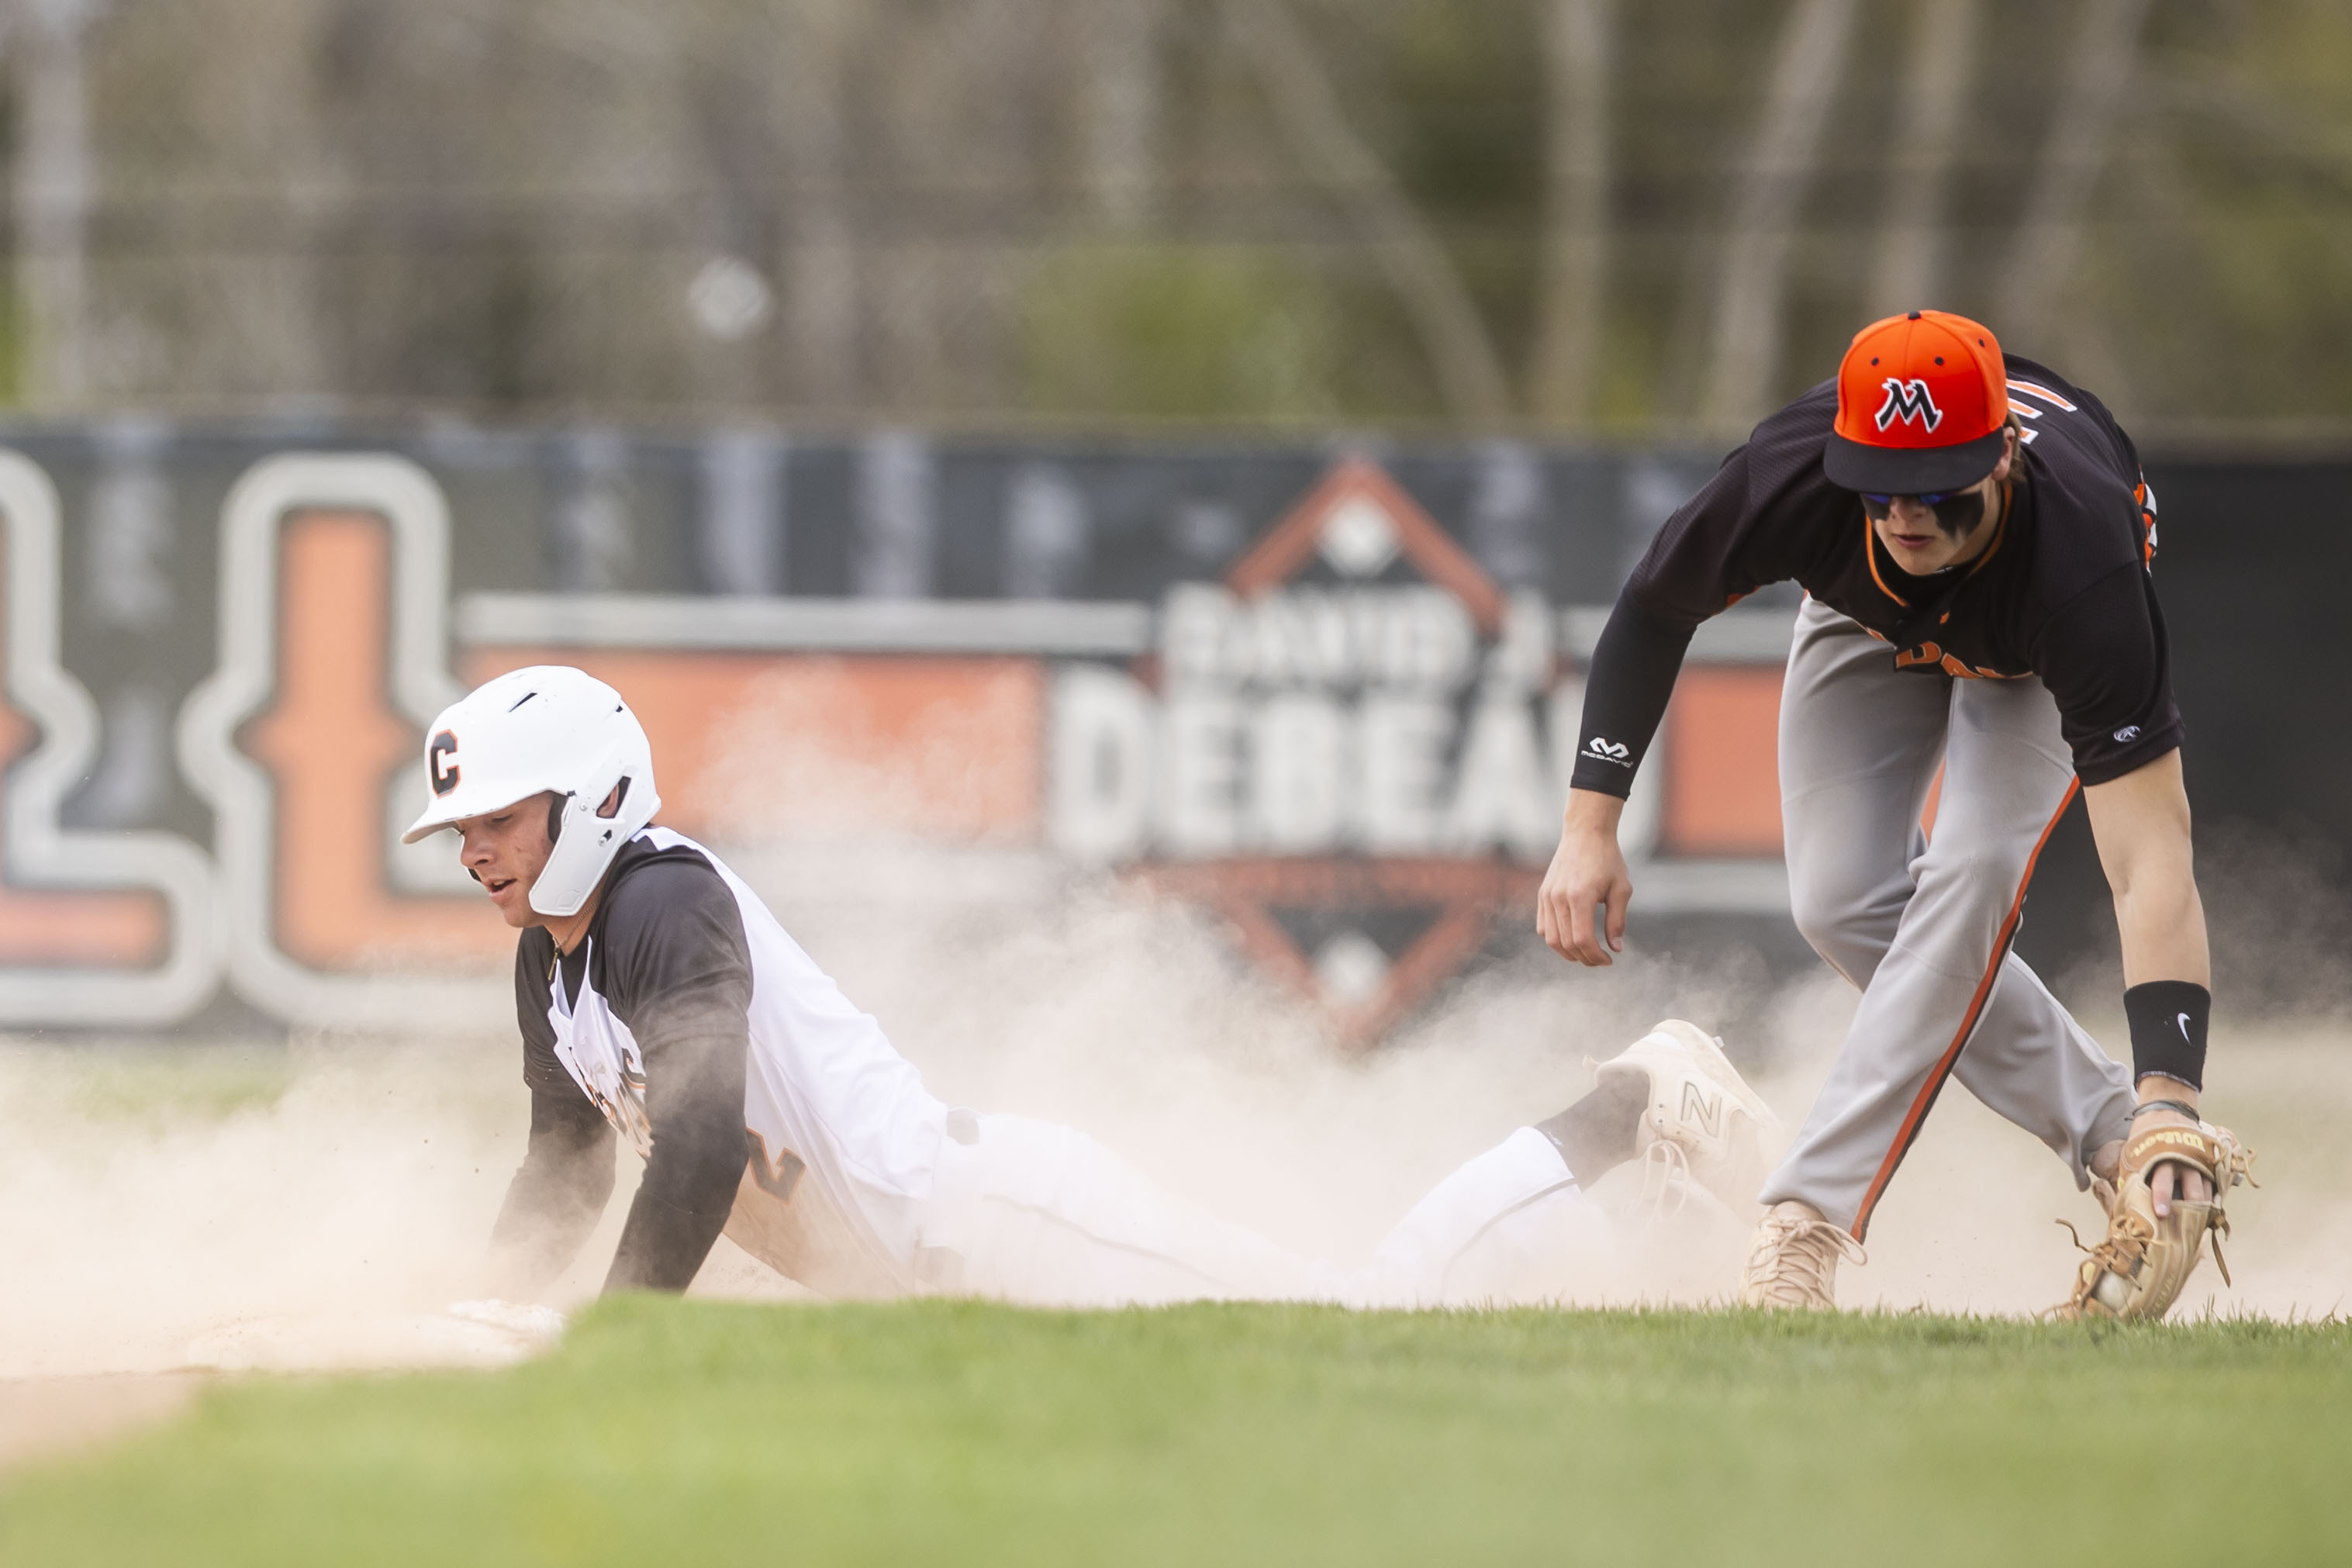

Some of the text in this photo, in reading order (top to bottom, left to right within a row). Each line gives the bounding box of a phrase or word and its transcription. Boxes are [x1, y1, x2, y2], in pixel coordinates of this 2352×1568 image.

[1874, 377, 1943, 434] M
[430, 729, 461, 800] C
[1682, 1081, 1722, 1138] N
